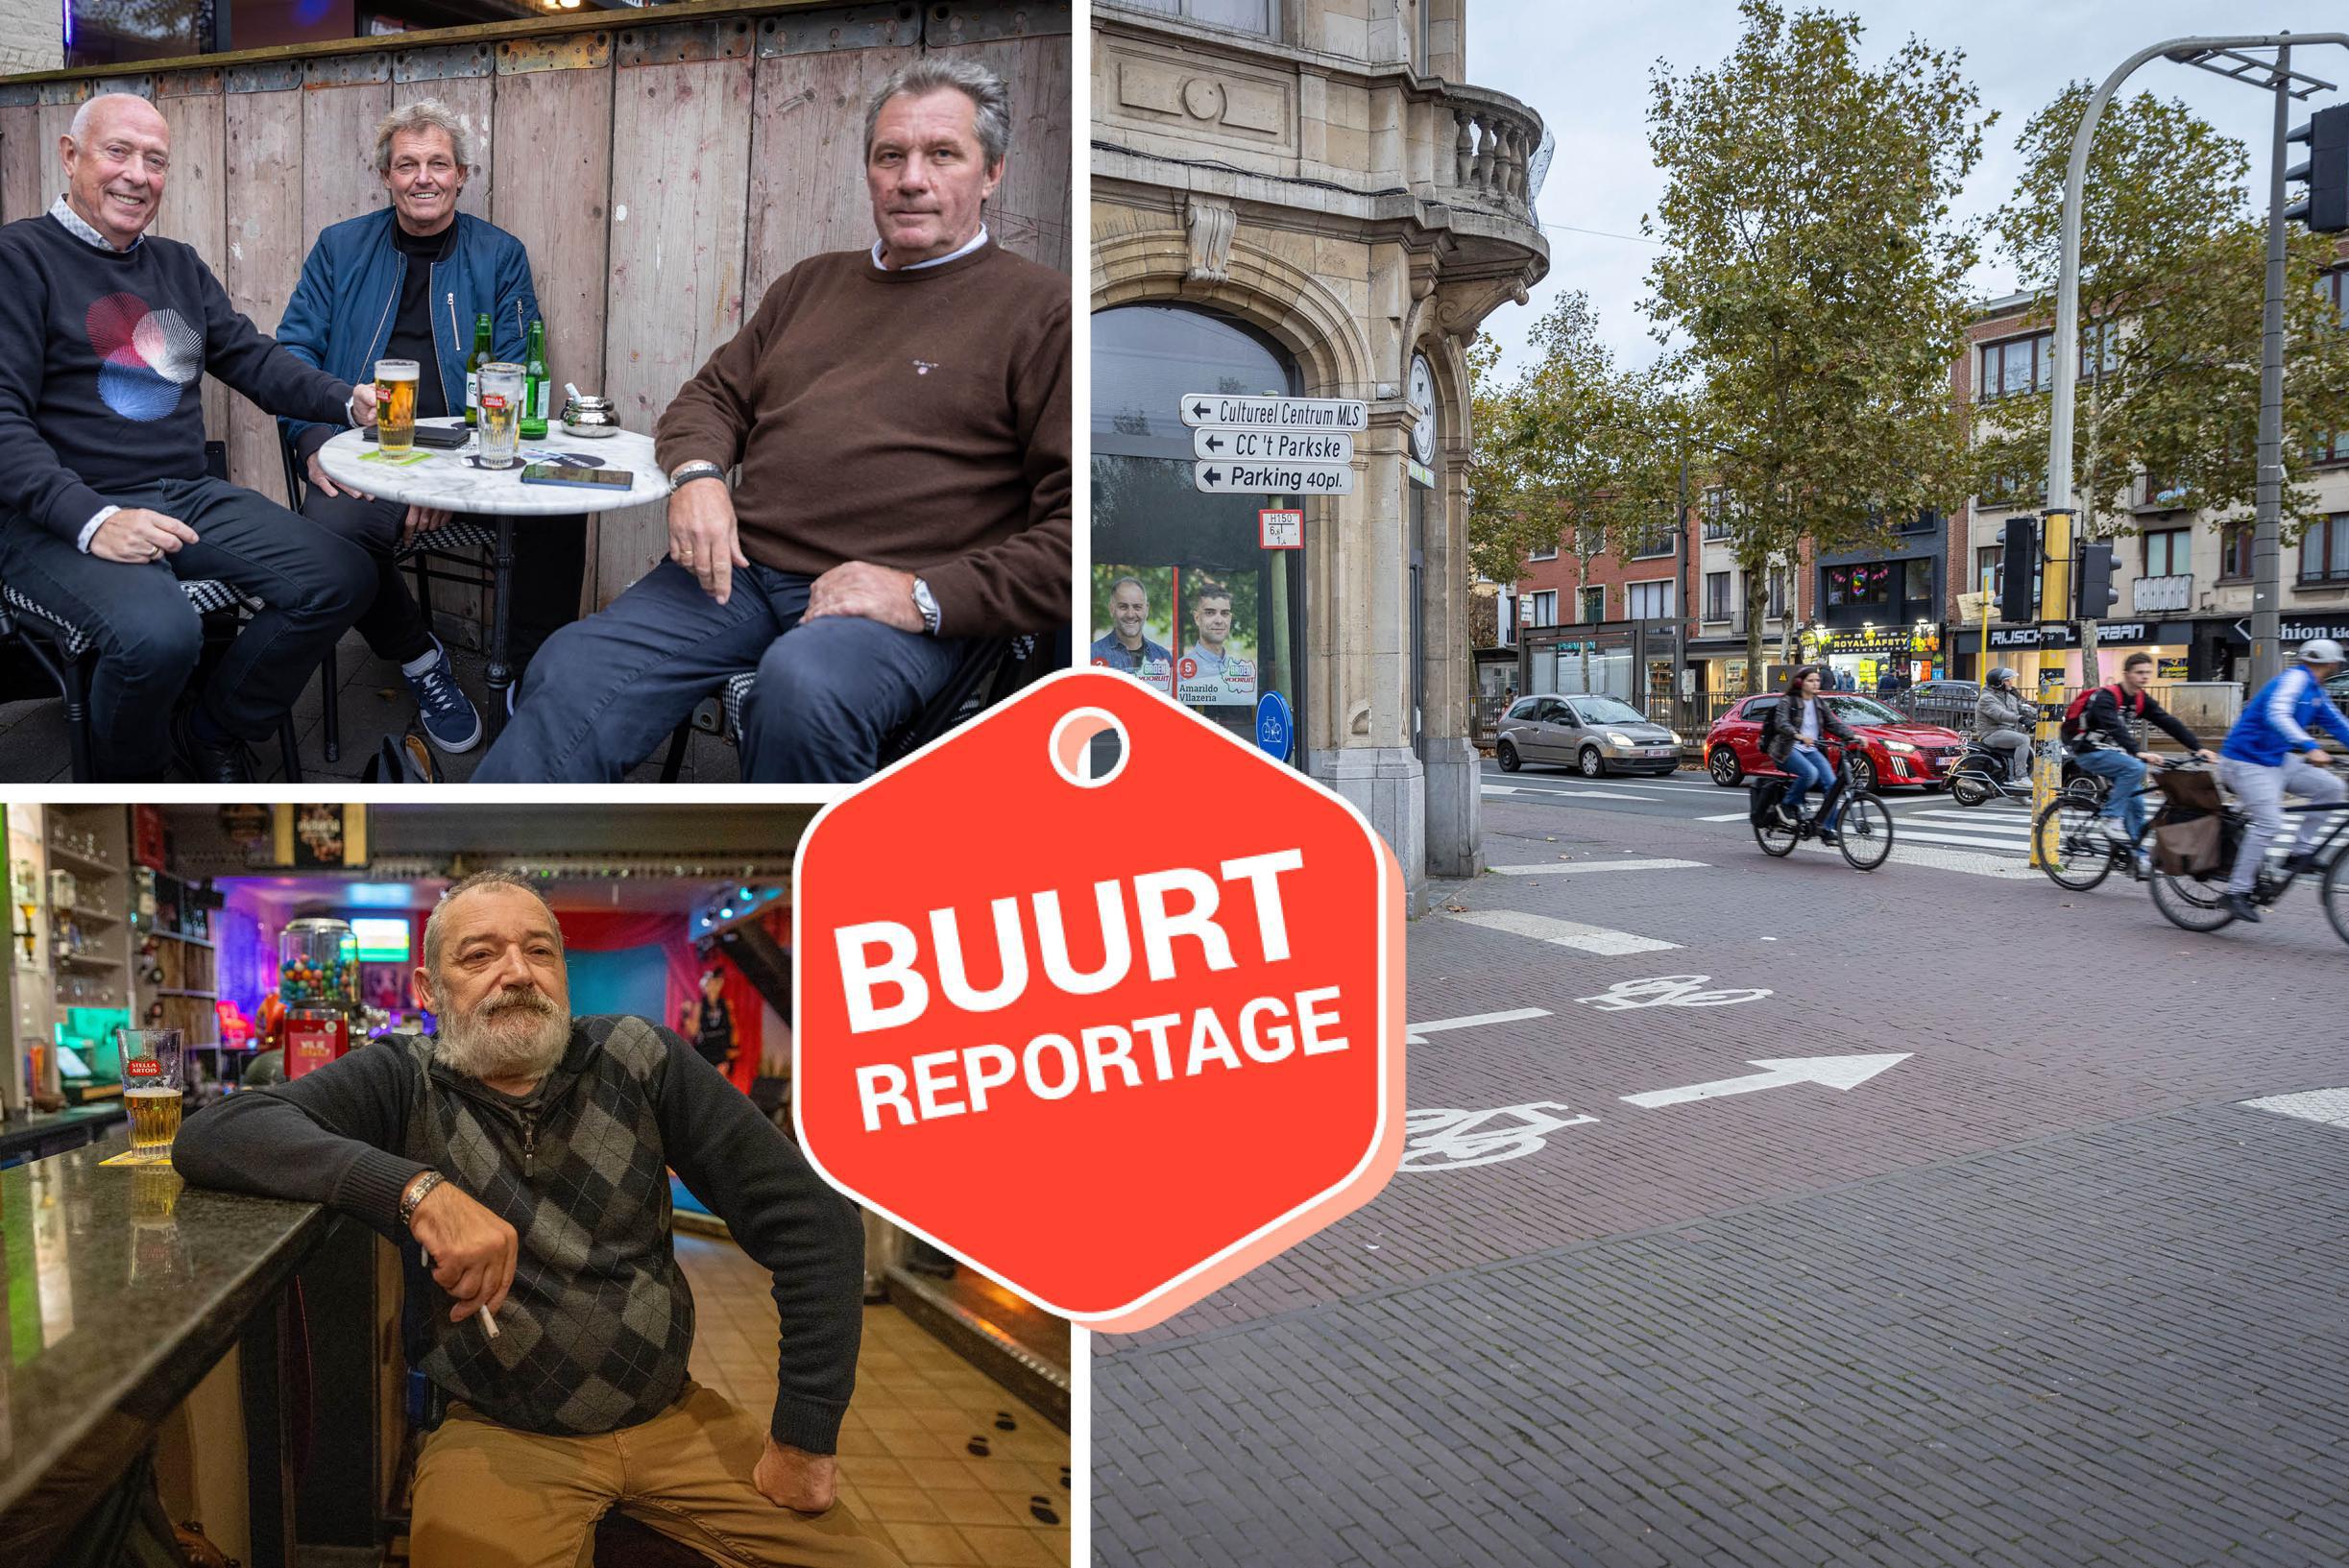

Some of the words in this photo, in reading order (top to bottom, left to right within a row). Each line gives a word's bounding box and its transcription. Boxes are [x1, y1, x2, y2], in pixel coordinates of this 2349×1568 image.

[1220, 399, 1278, 423] Cultureel
[1281, 402, 1334, 425] Centrum
[1337, 404, 1360, 426] MLS
[1236, 433, 1258, 456] CC
[1263, 435, 1273, 456] 't
[1278, 435, 1341, 458] Parkske
[1230, 466, 1302, 491] Parking
[1306, 472, 1343, 491] 40pl.
[1270, 514, 1293, 523] H150
[1991, 627, 2075, 645] RIJSCHL
[2095, 623, 2144, 640] RBAN
[2277, 622, 2328, 640] hion
[1178, 692, 1217, 702] Vllazeria
[1179, 684, 1219, 693] Amarildo
